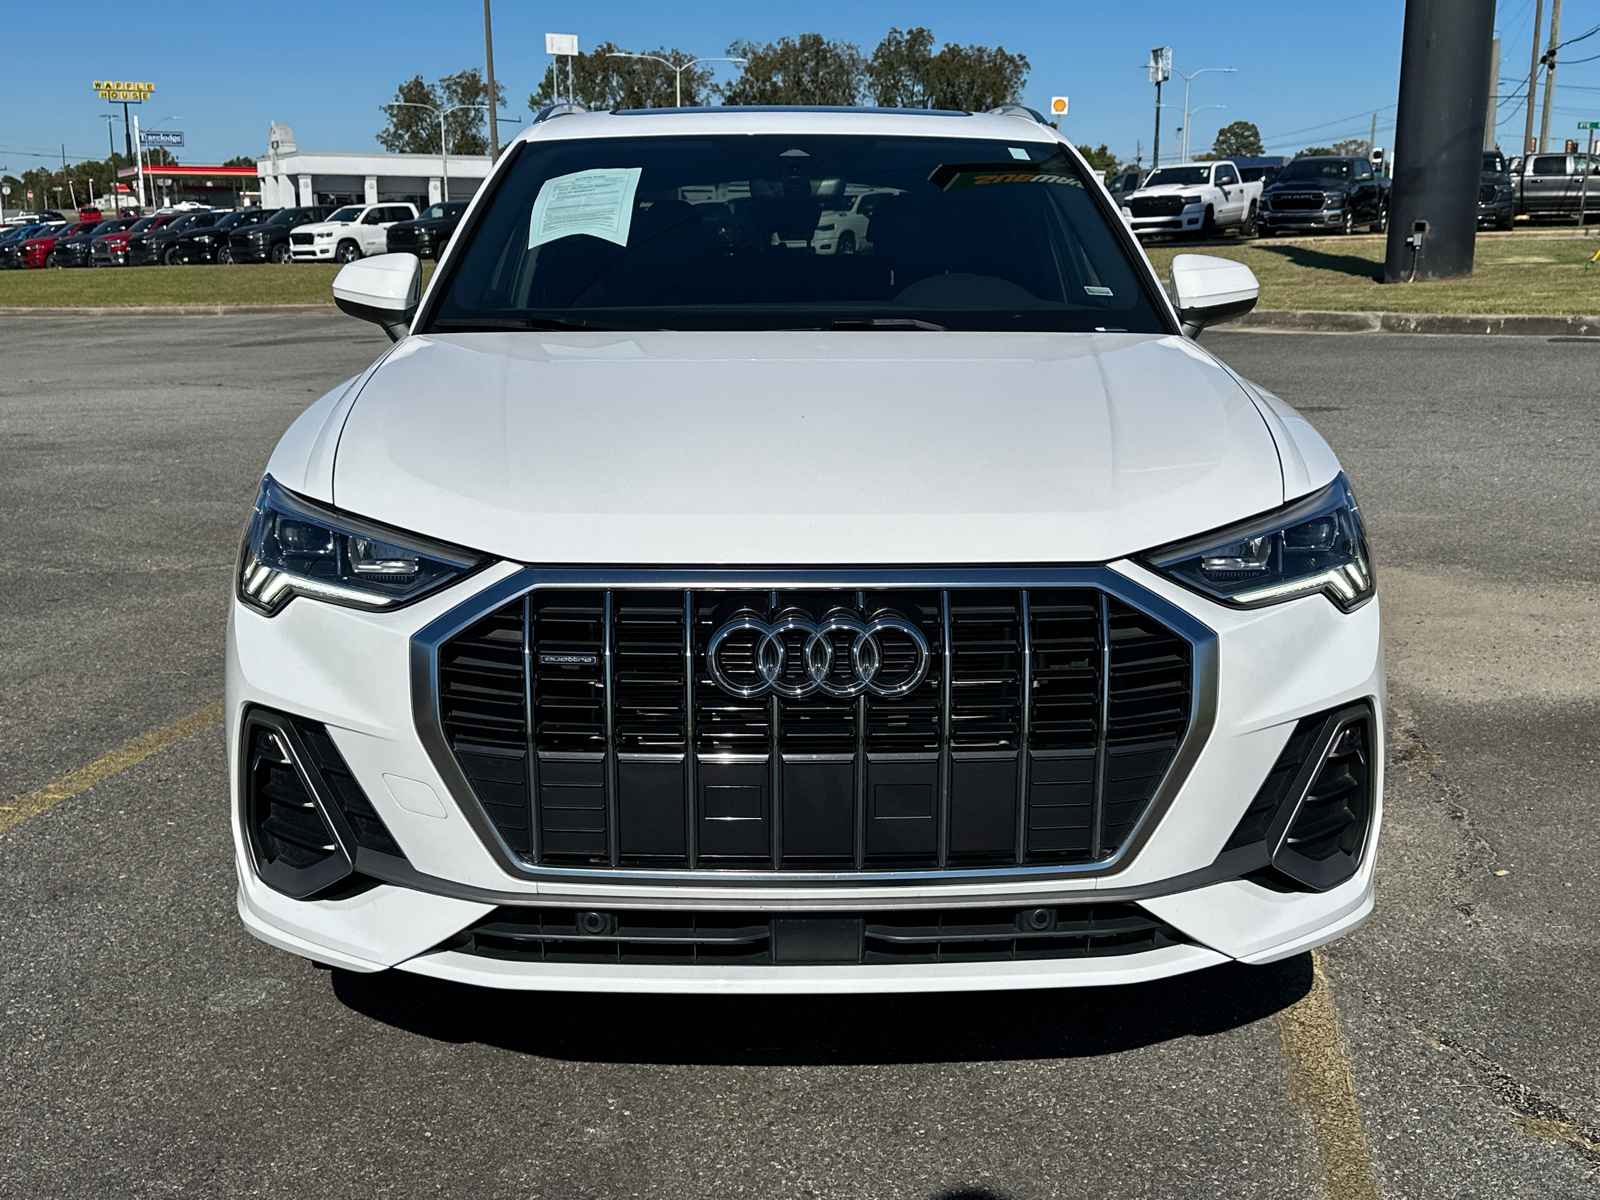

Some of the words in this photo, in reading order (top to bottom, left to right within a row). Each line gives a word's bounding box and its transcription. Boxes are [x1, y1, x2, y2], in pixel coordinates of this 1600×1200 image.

[94, 82, 153, 91] WAFFLE
[100, 91, 149, 99] HOUSE
[141, 133, 181, 143] Tavelodge
